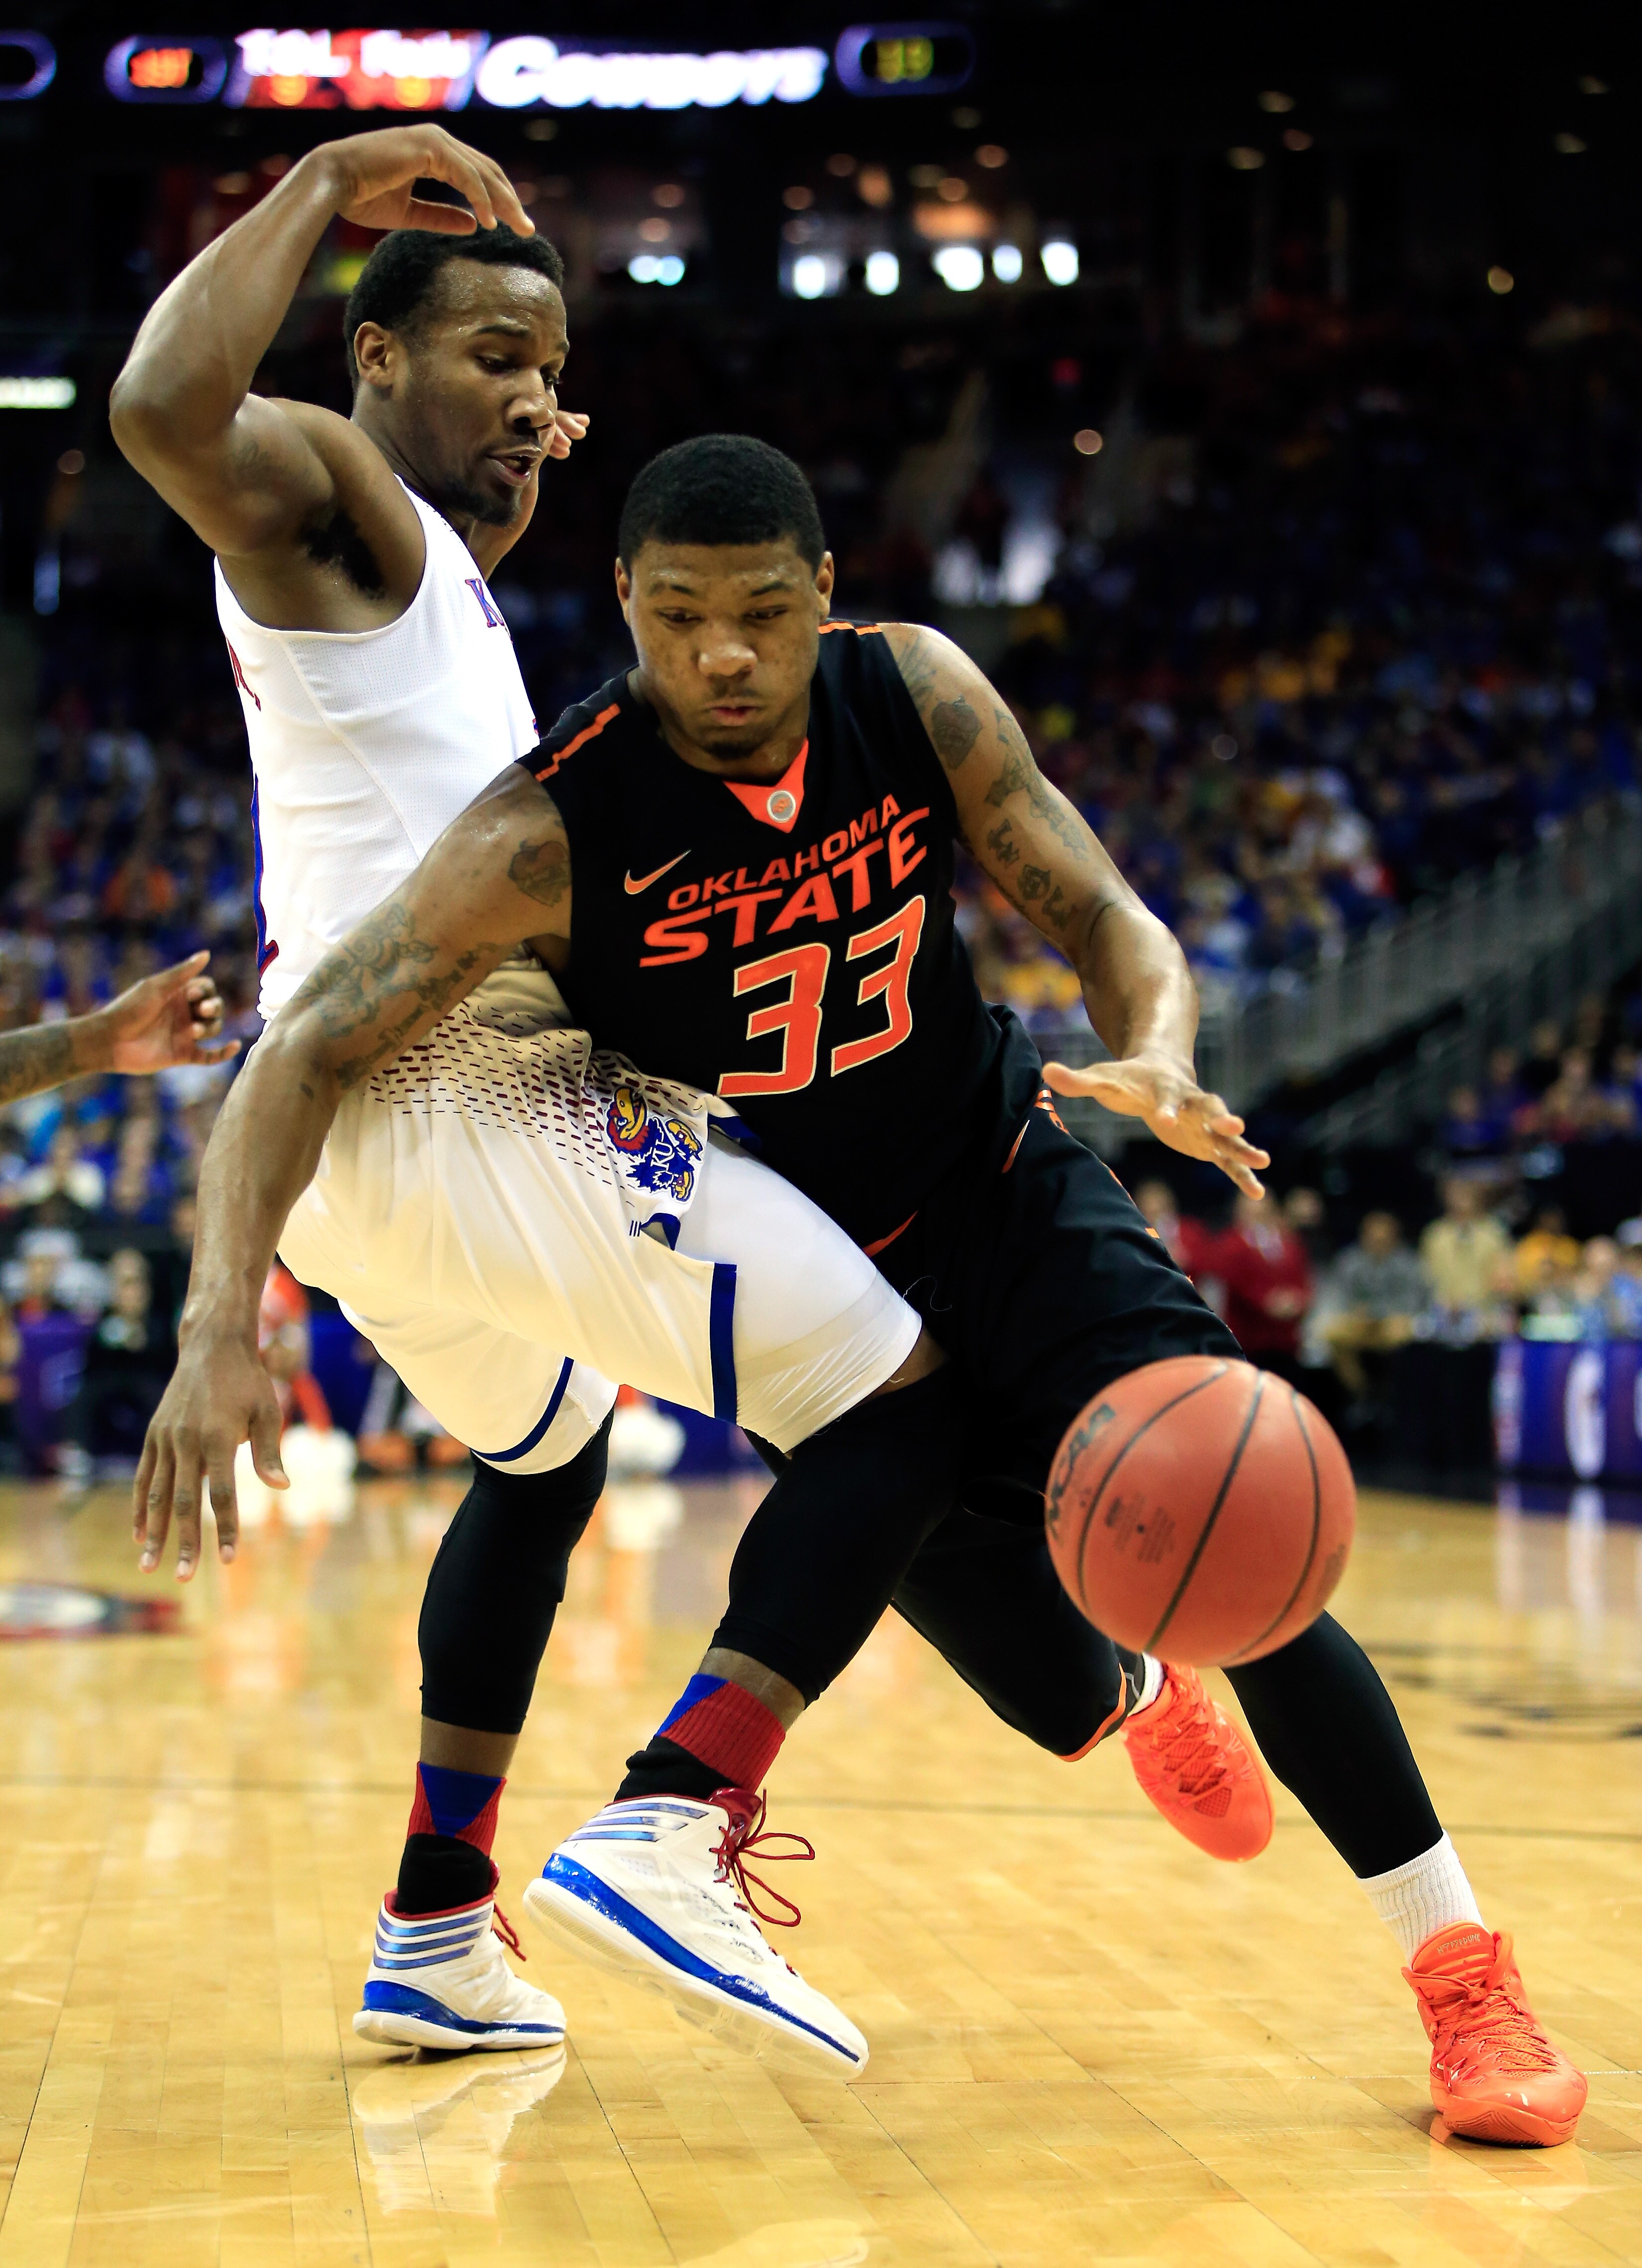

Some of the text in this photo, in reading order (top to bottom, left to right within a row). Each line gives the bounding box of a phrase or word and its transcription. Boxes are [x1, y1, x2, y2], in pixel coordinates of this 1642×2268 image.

[640, 806, 930, 968] STATE
[668, 794, 901, 910] OKLAHOMA
[717, 894, 926, 1097] 33
[650, 1139, 675, 1172] KU
